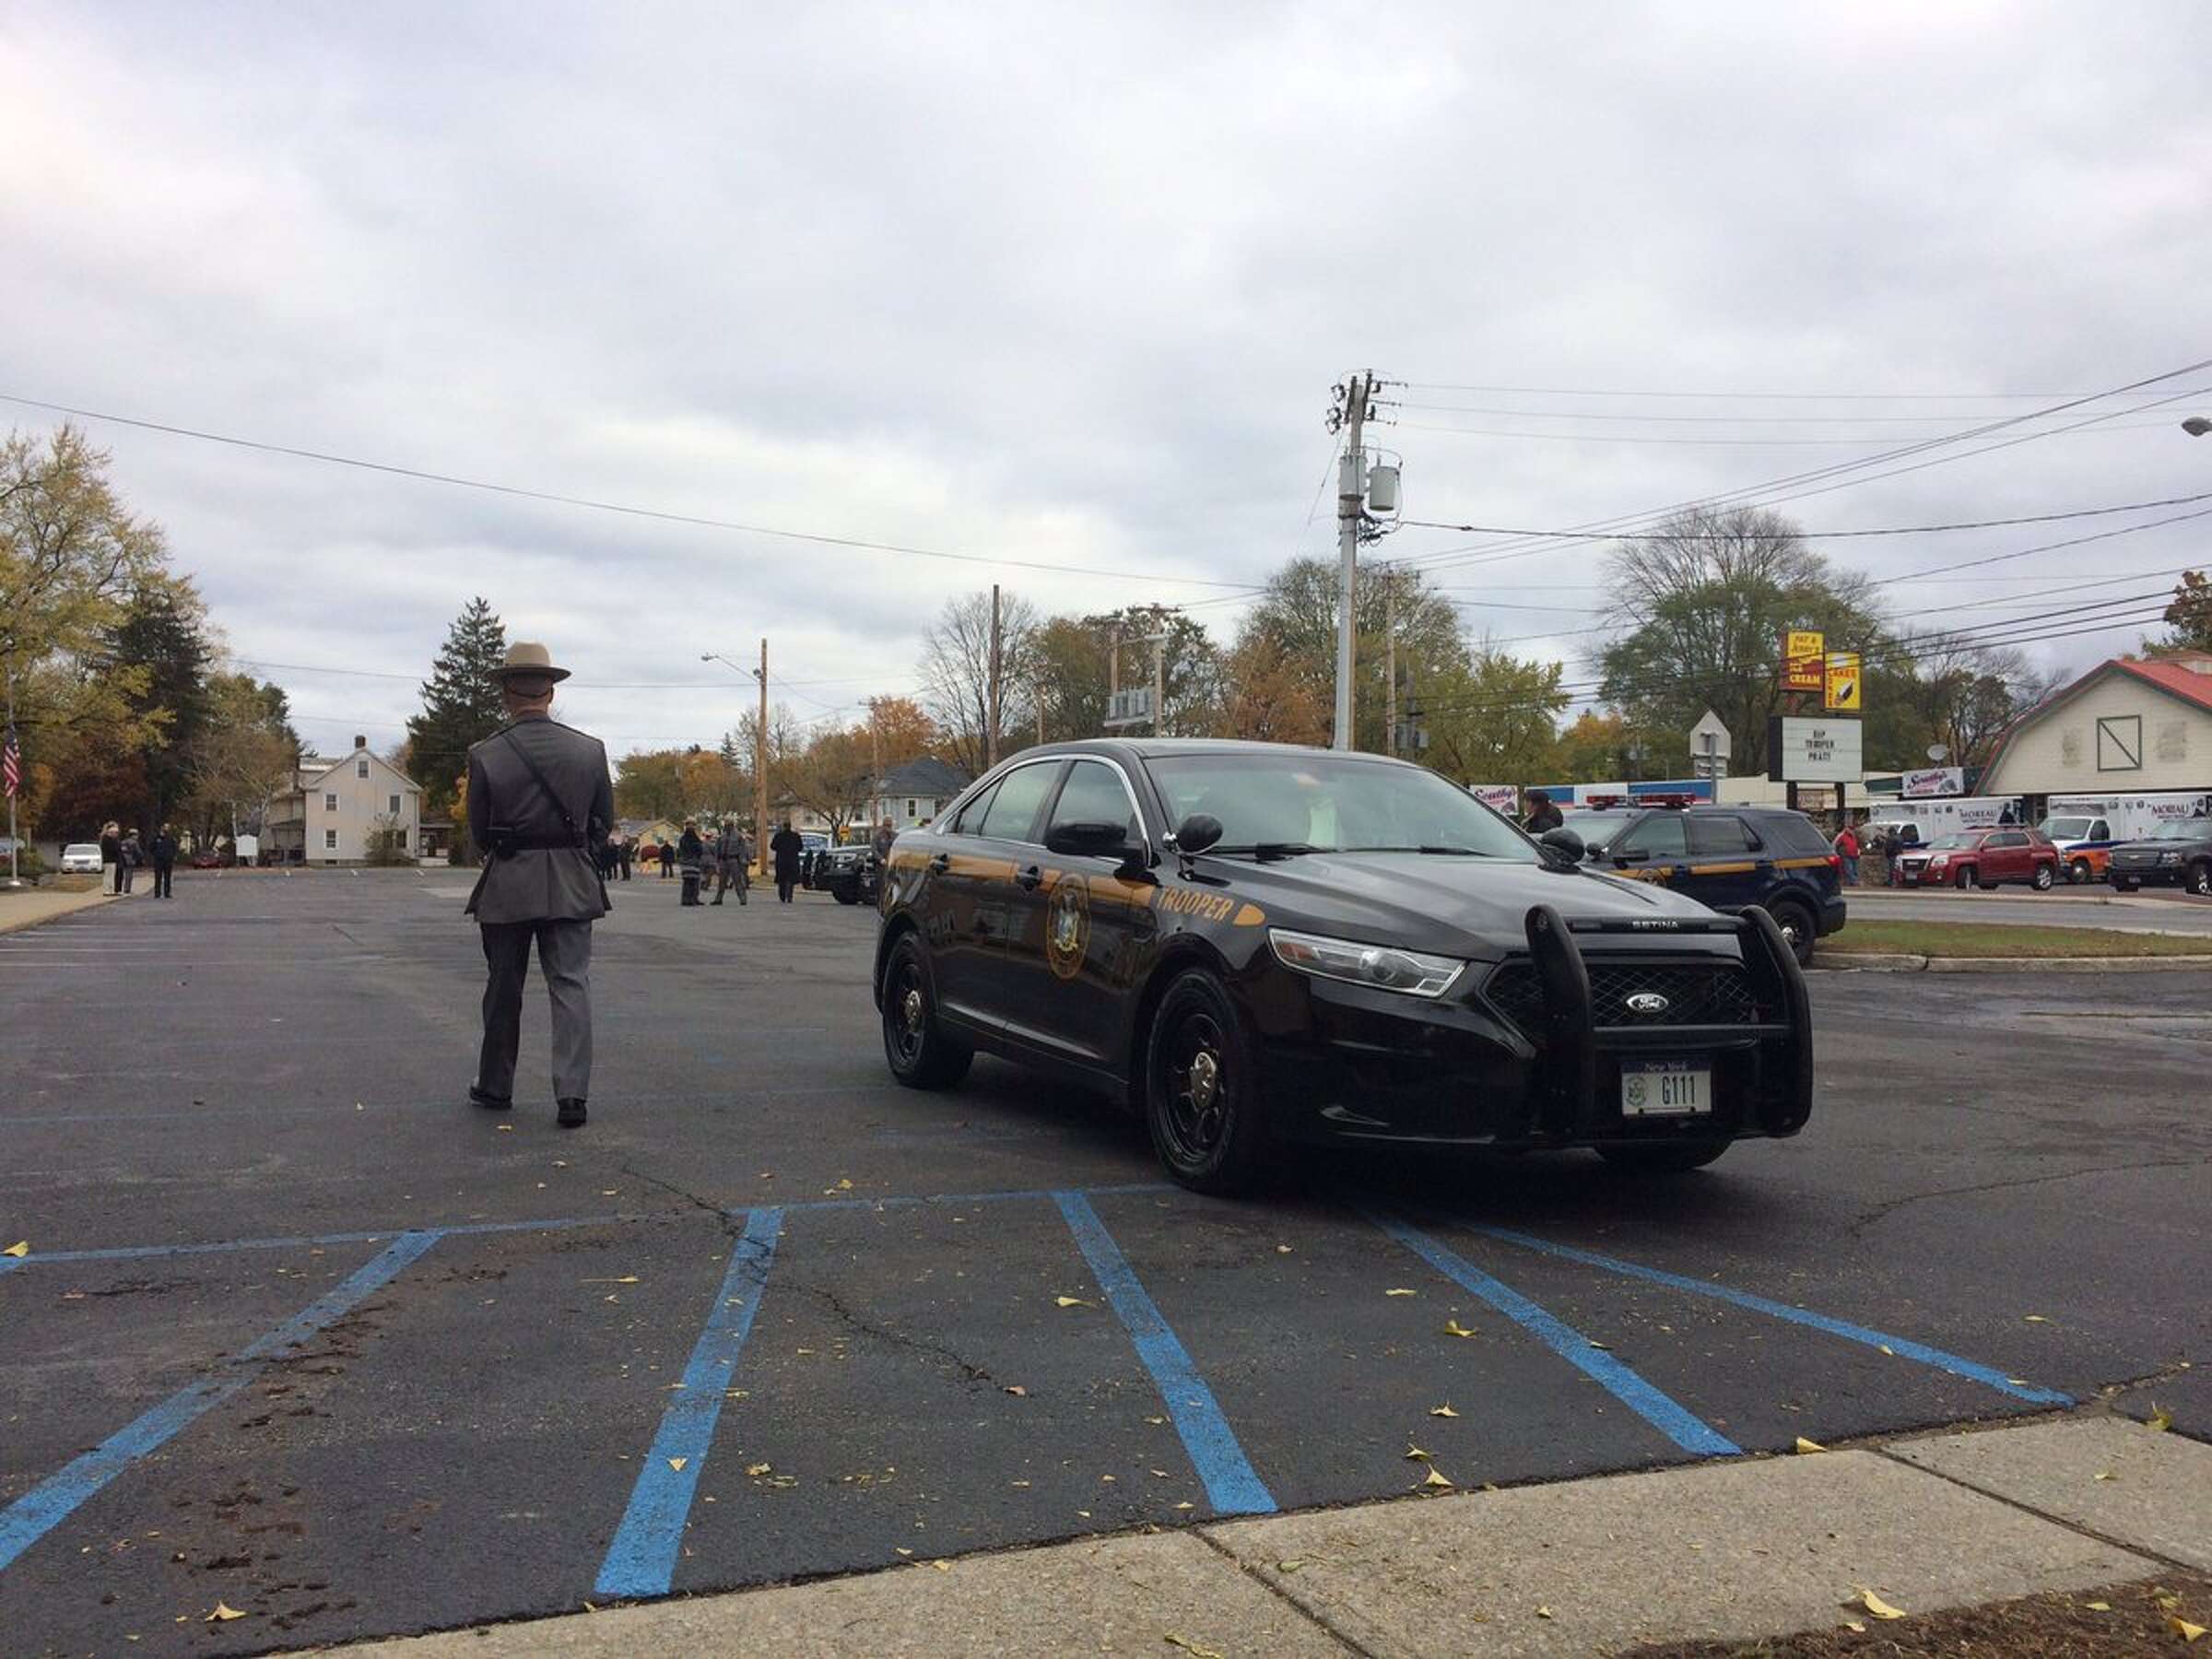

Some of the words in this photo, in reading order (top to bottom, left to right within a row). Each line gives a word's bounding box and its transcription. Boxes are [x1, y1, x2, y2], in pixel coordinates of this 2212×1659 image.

[1790, 675, 1821, 685] CREAM
[1960, 810, 1995, 818] MOREAU
[1158, 886, 1234, 921] TROOPER
[1662, 1075, 1696, 1105] G111
